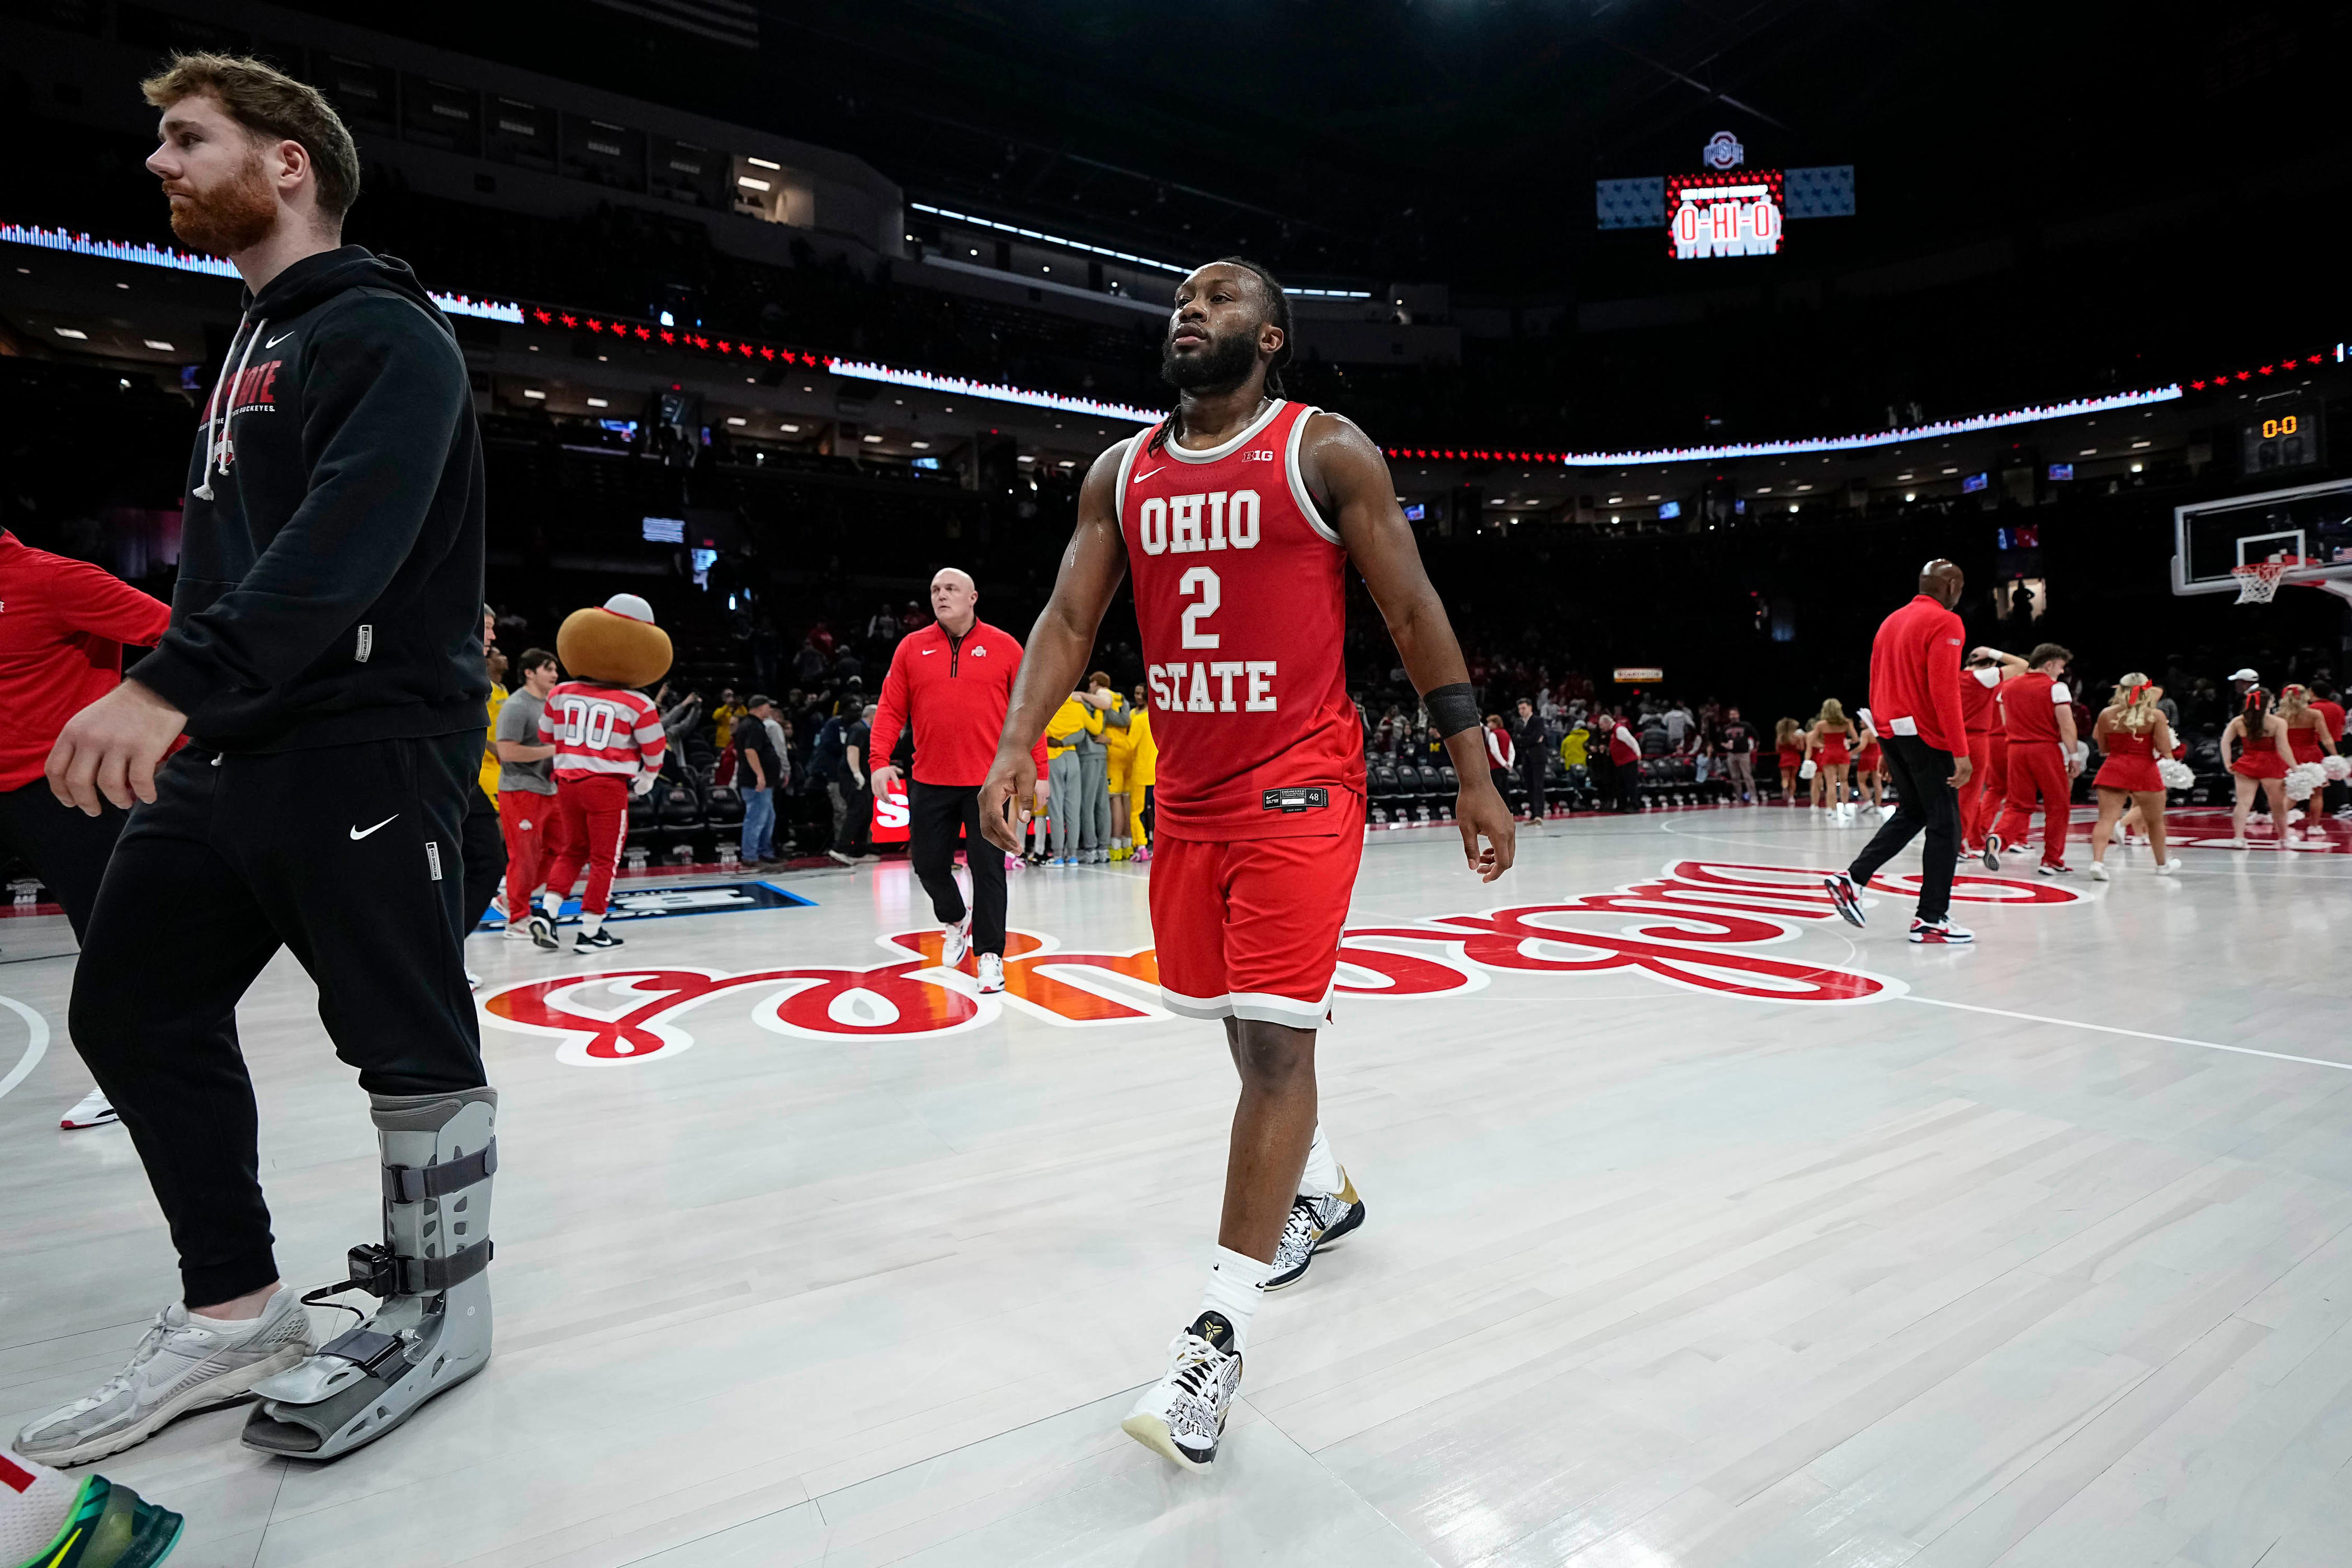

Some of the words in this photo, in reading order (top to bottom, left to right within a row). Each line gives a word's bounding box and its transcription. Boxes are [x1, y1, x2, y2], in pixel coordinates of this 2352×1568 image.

[1140, 489, 1260, 555] OHIO
[1179, 566, 1220, 649] 2
[1149, 661, 1277, 712] STATE
[563, 697, 616, 751] 00
